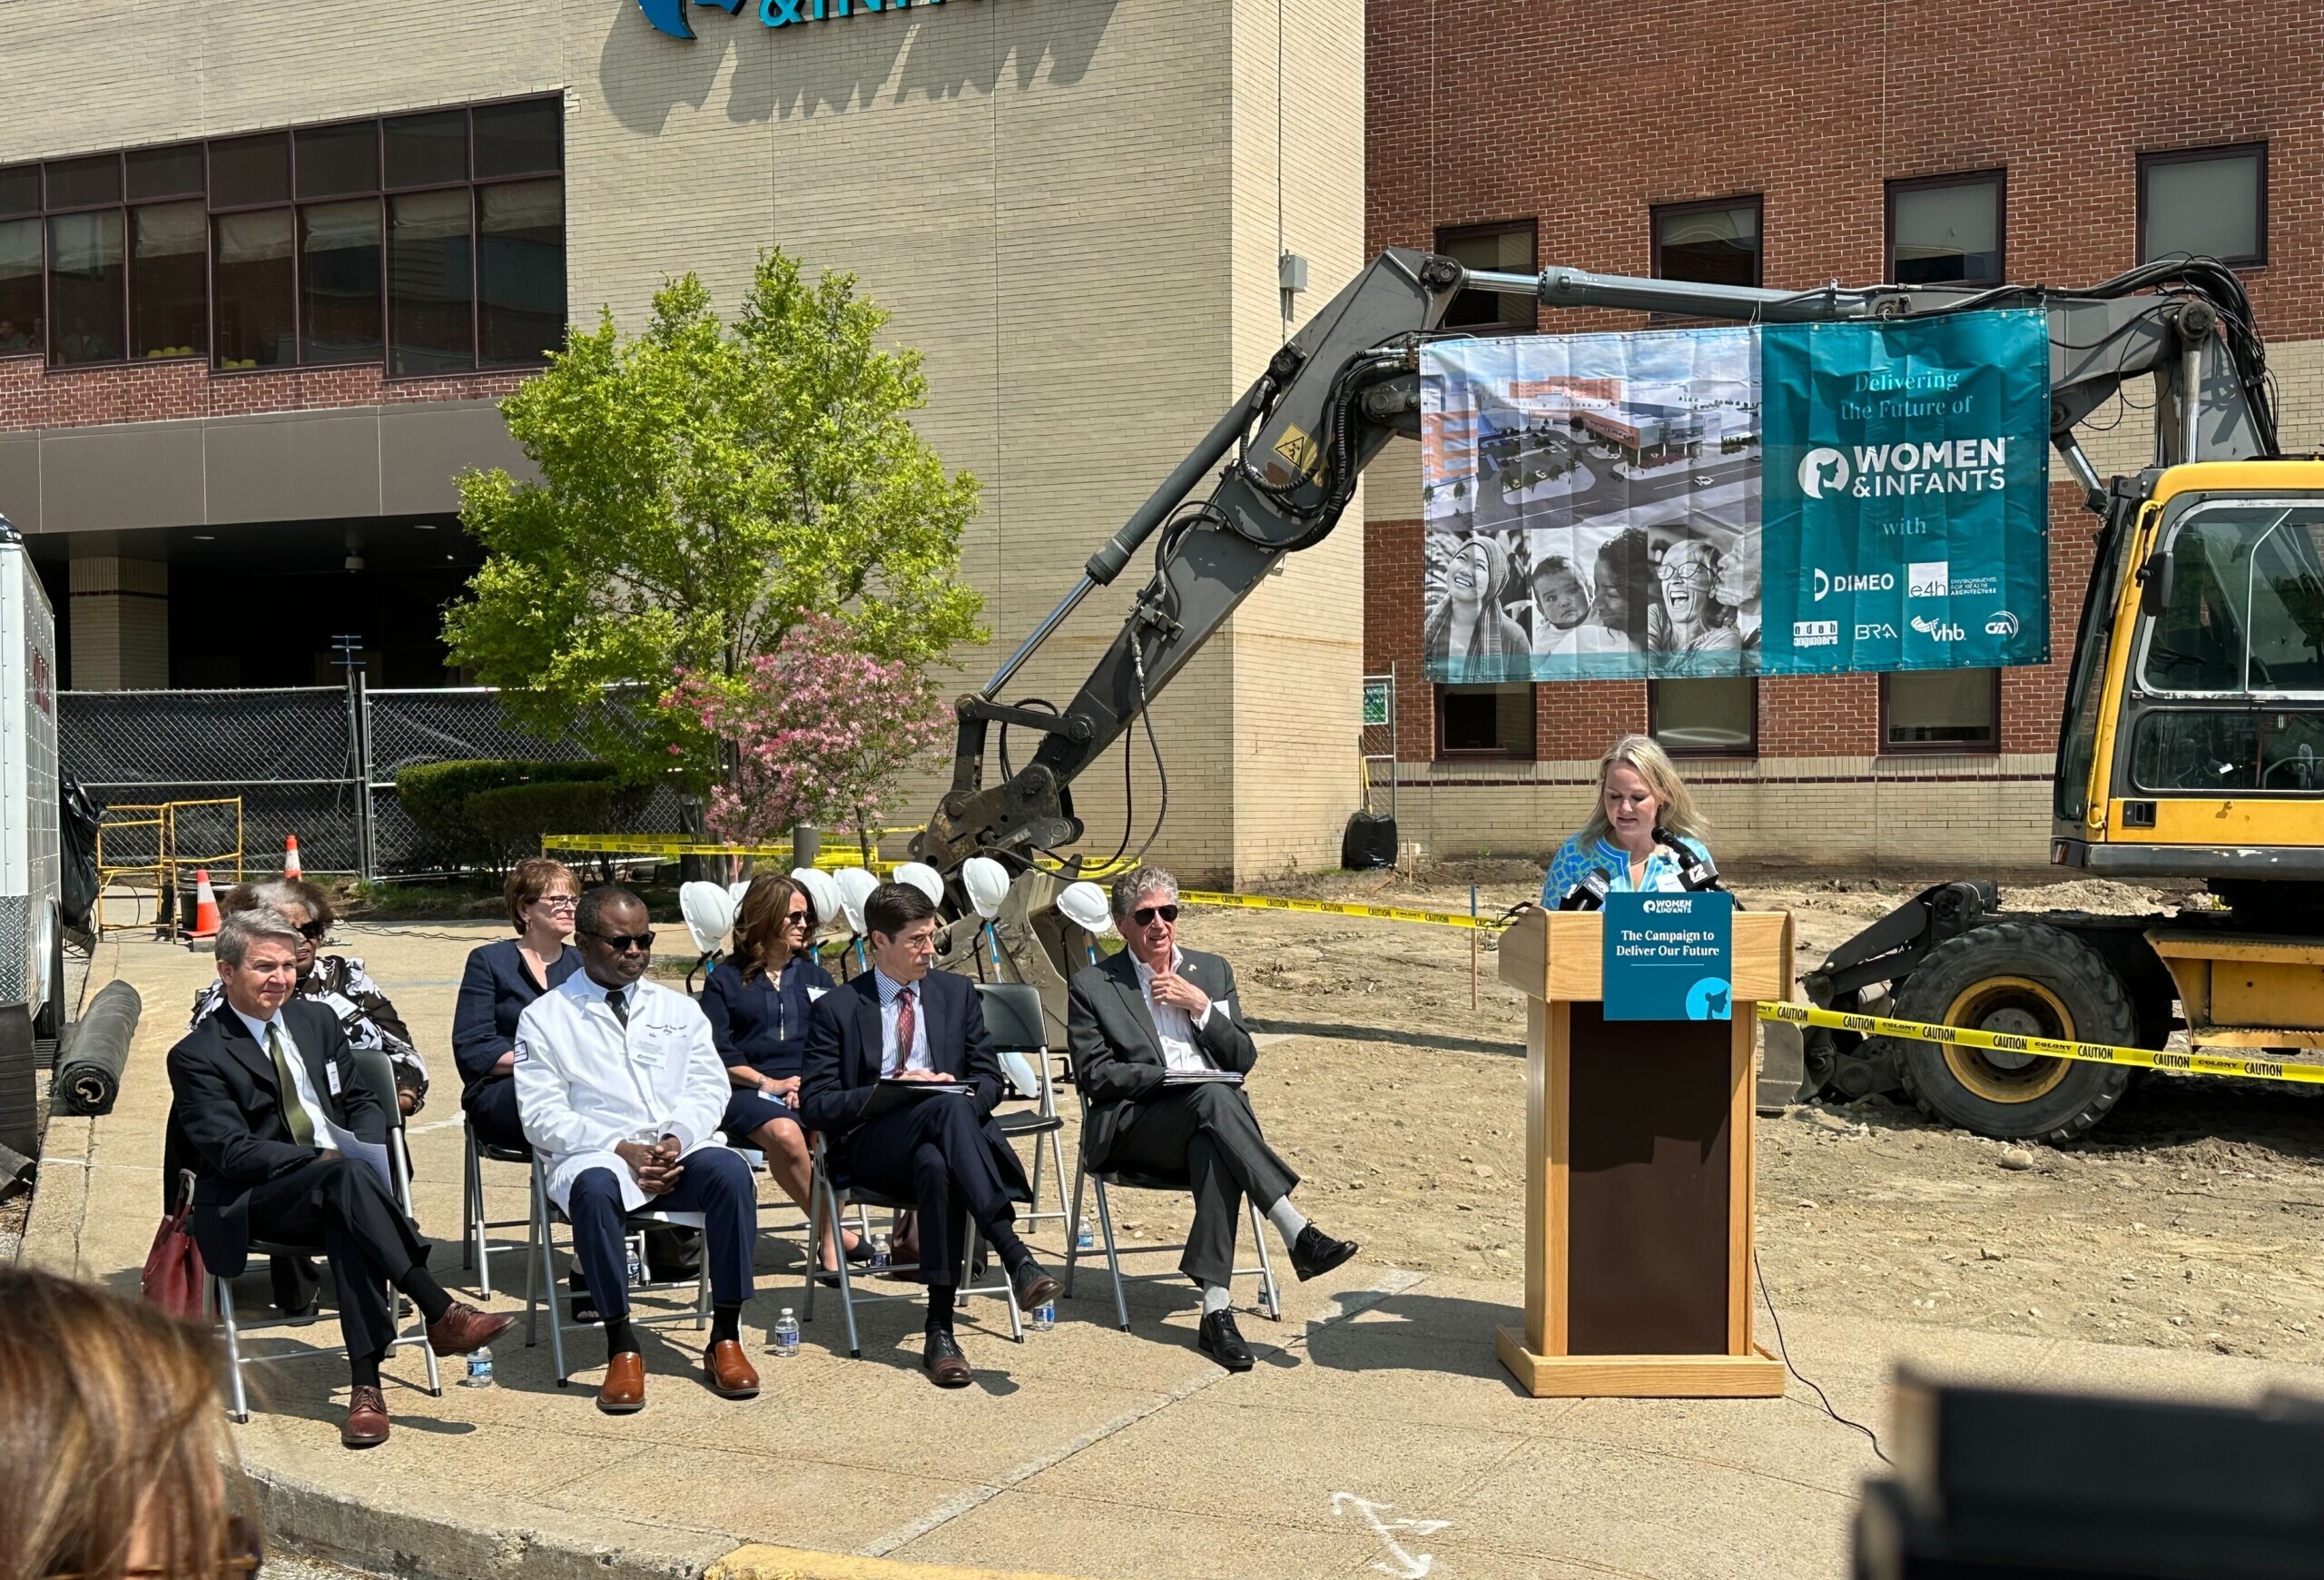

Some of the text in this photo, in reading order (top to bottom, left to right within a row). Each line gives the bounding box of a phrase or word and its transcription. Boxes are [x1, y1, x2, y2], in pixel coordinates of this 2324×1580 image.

[1855, 370, 1960, 392] Delivering
[1841, 395, 1974, 420] the Future of
[1853, 437, 2005, 474] WOMEN
[1852, 468, 2005, 499] &INFANTS
[1883, 517, 1926, 535] with
[1834, 573, 1895, 592] DIMEO
[1910, 580, 1946, 597] e4h
[1655, 899, 1692, 907] WOMEN
[1620, 929, 1715, 943] The Campaign to
[1616, 945, 1720, 956] Deliver Our Future
[1777, 1006, 1808, 1022] CAUTION
[1843, 1015, 1876, 1032] CAUTION
[1922, 1026, 1955, 1042] CAUTION
[1993, 1034, 2027, 1051] CAUTION
[2034, 1041, 2072, 1051] COLONY
[2077, 1045, 2113, 1060] CAUTION
[2152, 1053, 2191, 1069] CAUTION
[2198, 1059, 2238, 1069] COLONY
[2244, 1062, 2282, 1077] CAUTION
